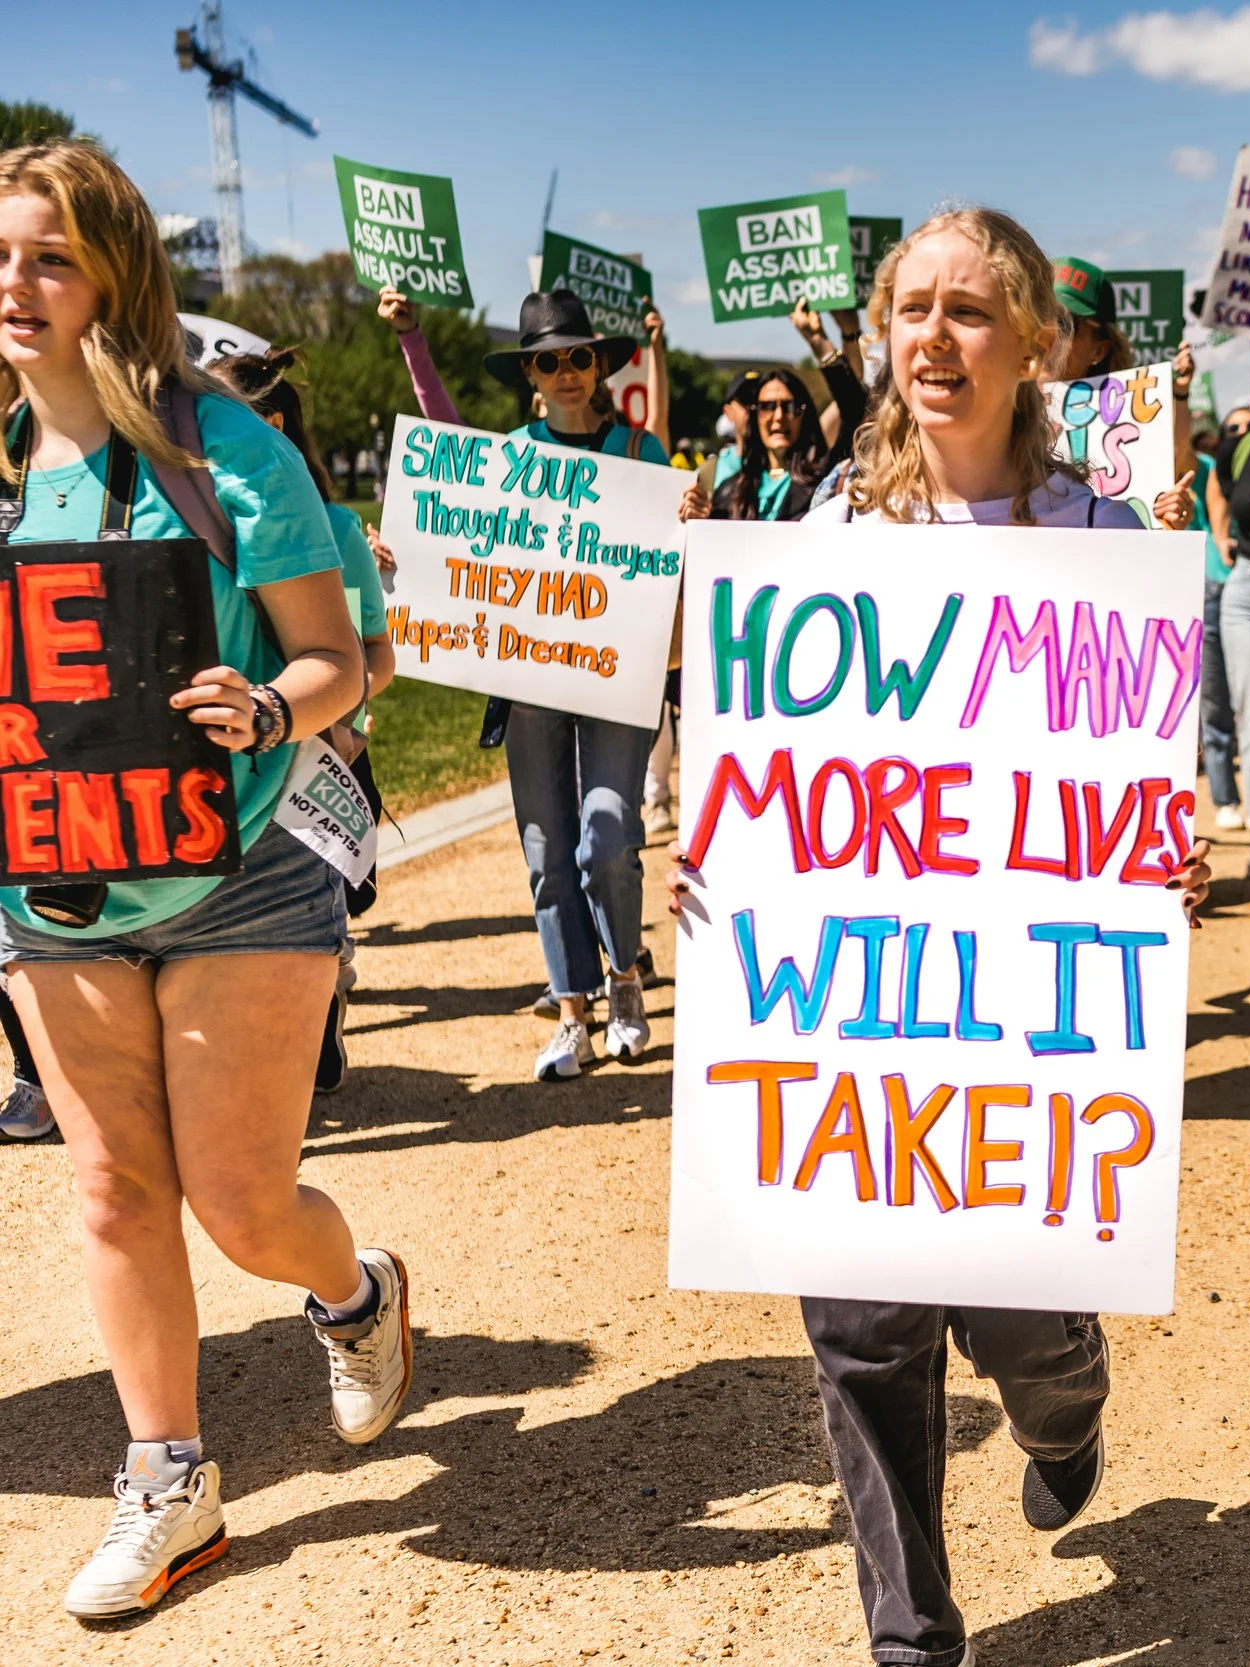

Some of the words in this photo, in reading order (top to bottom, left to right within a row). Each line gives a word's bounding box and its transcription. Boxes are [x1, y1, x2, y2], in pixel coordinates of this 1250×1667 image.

[360, 184, 415, 222] BAN
[747, 213, 814, 246] BAN
[353, 247, 463, 296] WEAPONS
[354, 218, 446, 263] ASSAULT
[576, 253, 626, 287] BAN
[725, 245, 839, 283] ASSAULT
[718, 273, 849, 311] WEAPONS
[402, 425, 491, 486] SAVE
[500, 440, 600, 508] YOUR
[413, 490, 547, 556] Thoughts
[576, 522, 680, 581] Prayers
[446, 557, 535, 608] THEY
[537, 570, 607, 620] HAD
[386, 605, 469, 663] Hopes
[497, 624, 618, 678] Dreams
[709, 576, 964, 721] HOW
[959, 594, 1203, 739] MANY
[312, 779, 363, 831] KIDS
[318, 753, 373, 828] PROTECT
[684, 747, 980, 880] MORE
[1005, 770, 1195, 885] LIVES
[288, 792, 320, 817] NOT
[318, 817, 361, 857] AR-15s
[731, 908, 1003, 1041] WILL
[1024, 922, 1169, 1056] IT
[706, 1059, 1155, 1242] TAKE!?
